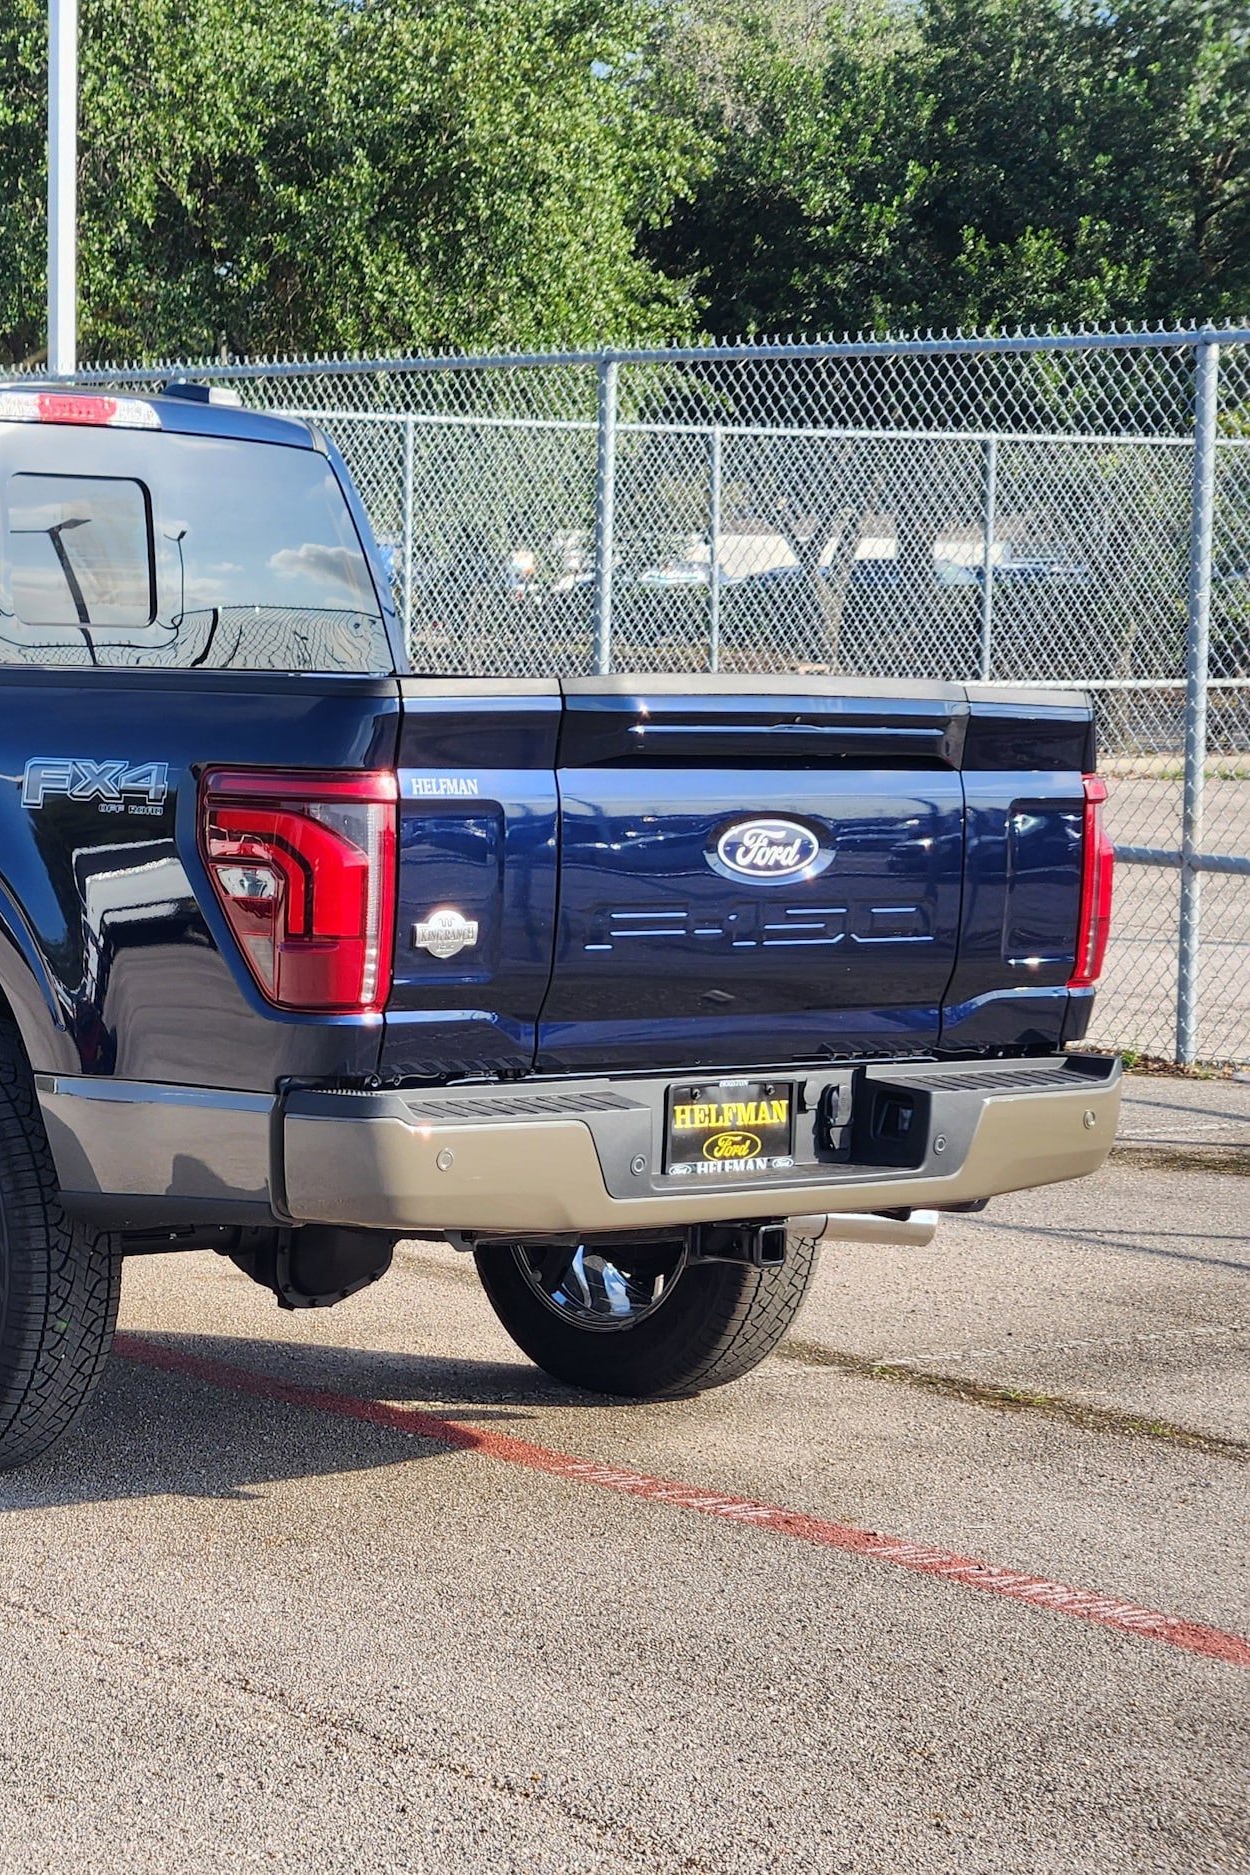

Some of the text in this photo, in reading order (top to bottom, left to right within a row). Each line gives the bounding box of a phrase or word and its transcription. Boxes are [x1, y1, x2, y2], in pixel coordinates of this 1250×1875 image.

[21, 757, 169, 808] FX4
[411, 778, 479, 795] HELFMAN
[98, 803, 163, 816] OFF ROAD
[735, 828, 800, 867] Ford
[674, 1100, 789, 1129] HELFMAN
[713, 1135, 751, 1158] Ford
[696, 1158, 768, 1174] HELFMAN
